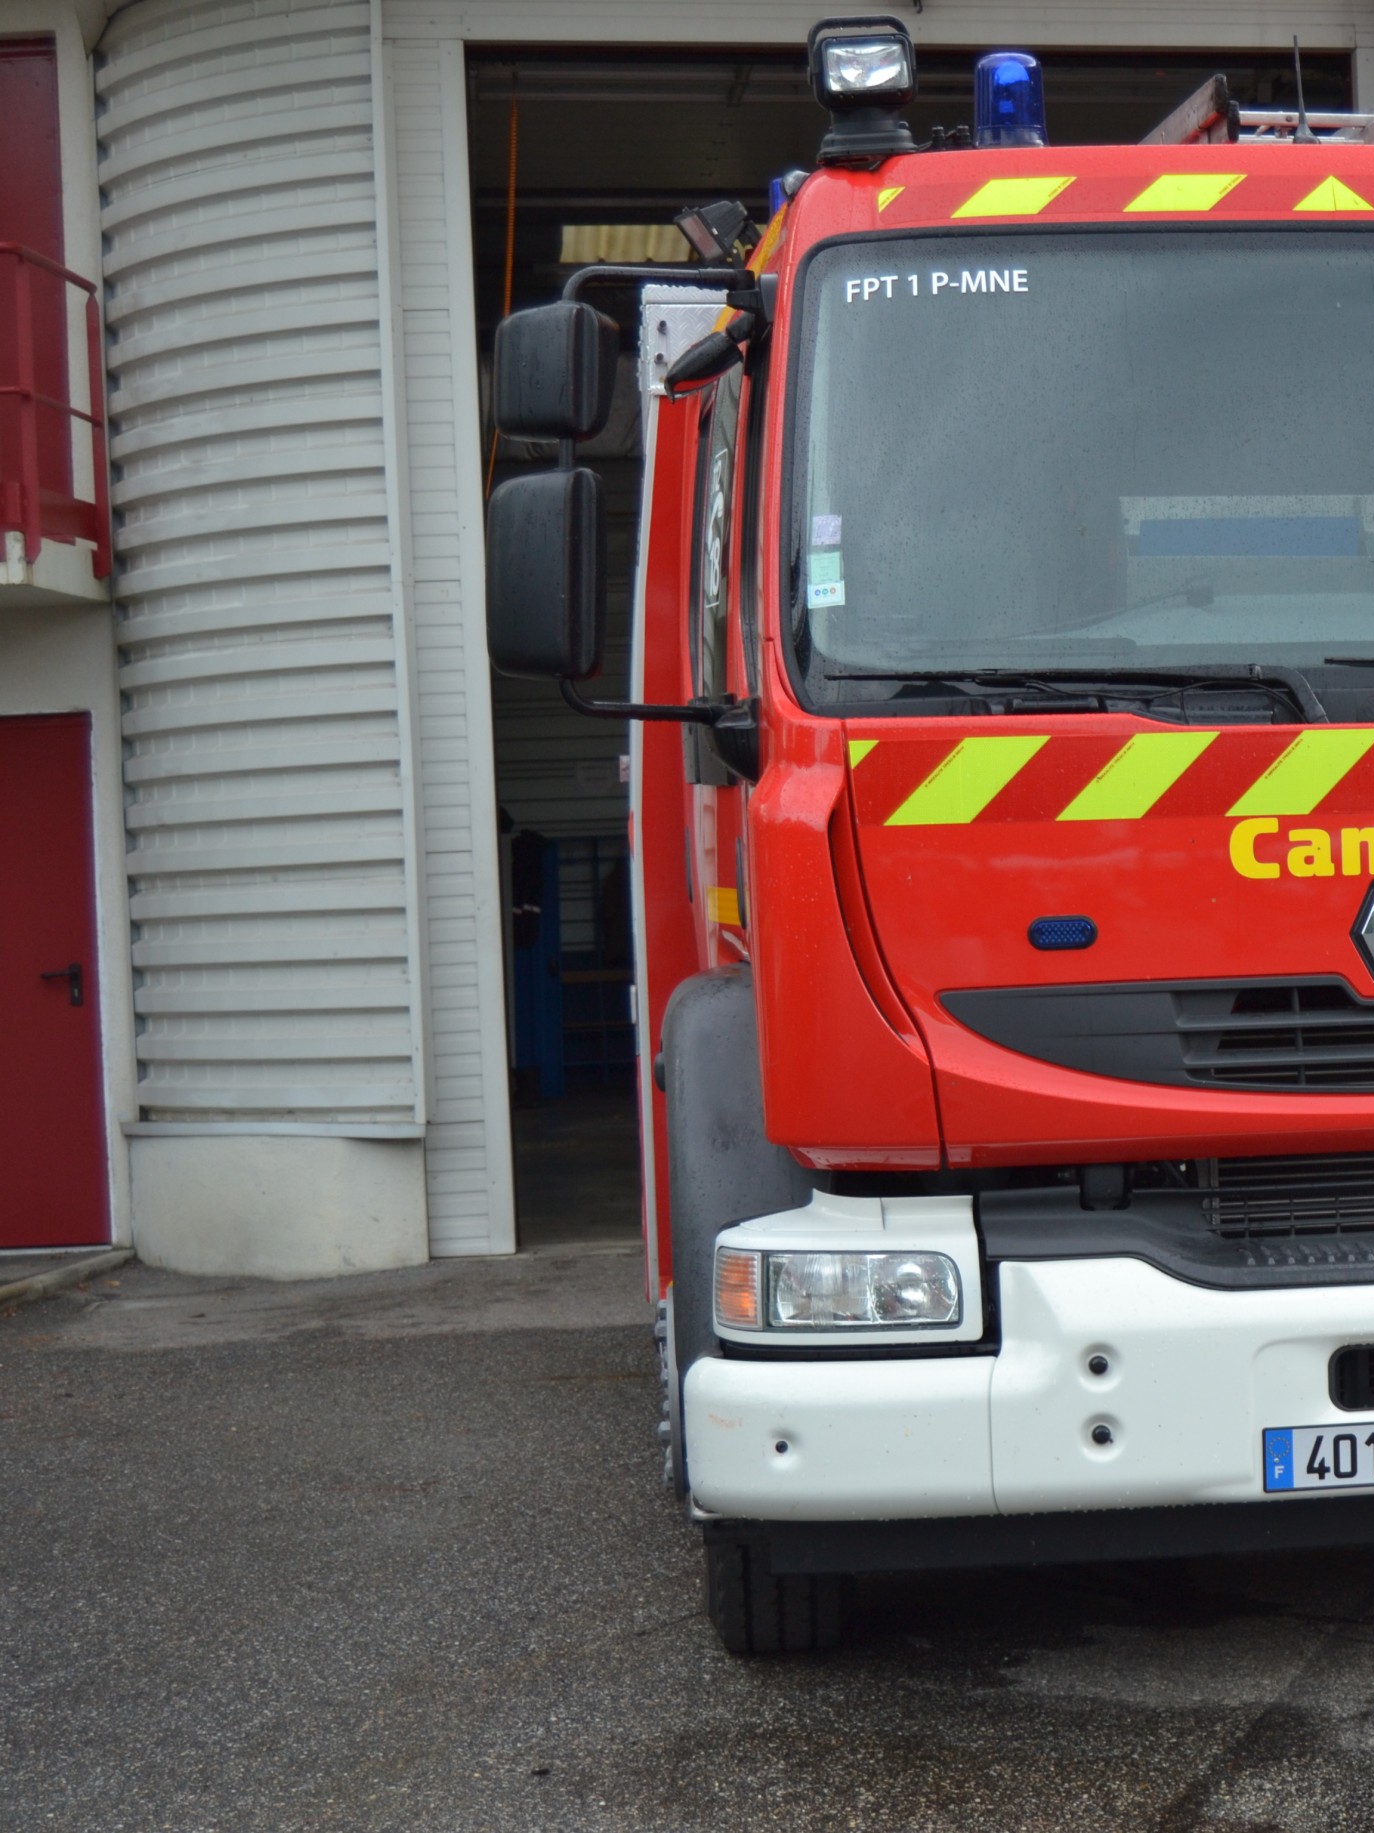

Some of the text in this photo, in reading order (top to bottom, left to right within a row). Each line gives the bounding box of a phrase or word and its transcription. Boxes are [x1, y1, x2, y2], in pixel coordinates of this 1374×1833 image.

[846, 270, 1029, 302] FPT 1 P-MNE
[1274, 1466, 1285, 1479] F
